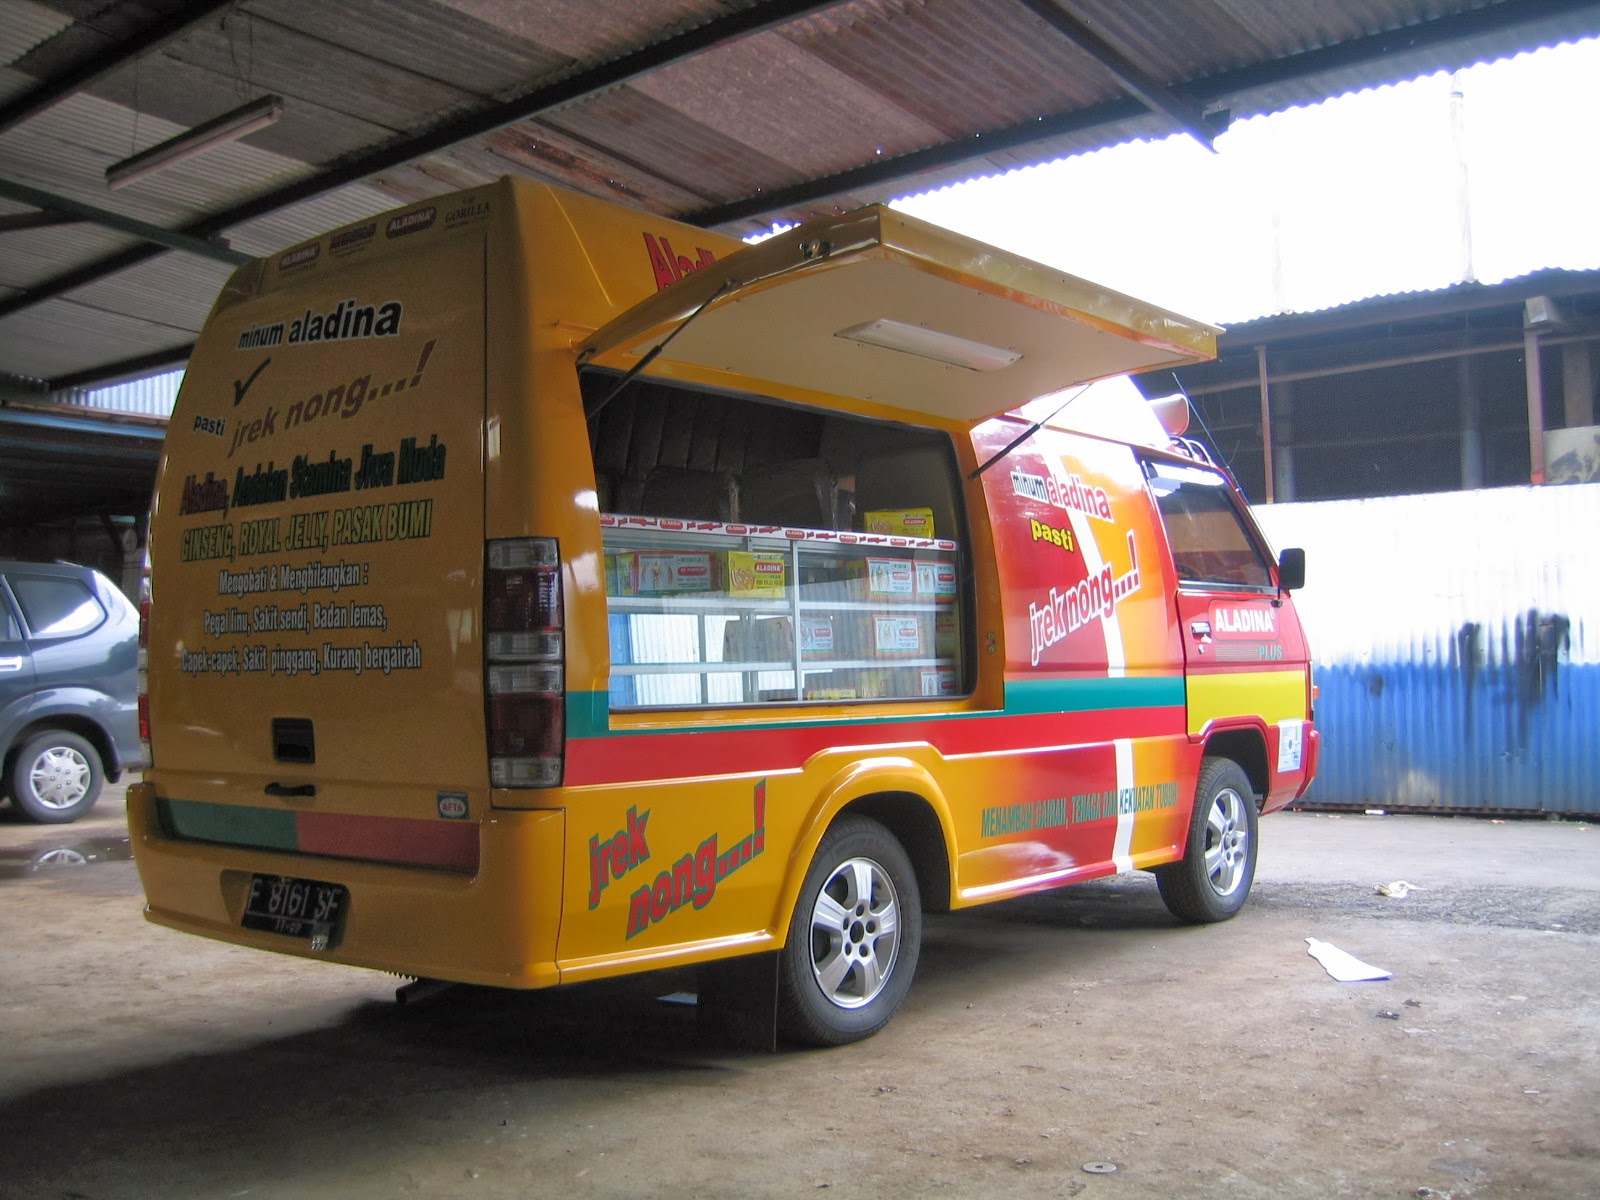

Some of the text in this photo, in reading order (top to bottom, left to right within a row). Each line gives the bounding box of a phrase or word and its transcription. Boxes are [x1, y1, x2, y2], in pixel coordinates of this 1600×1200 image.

[390, 209, 432, 231] ALADINA
[237, 300, 402, 349] minum aladina
[193, 414, 226, 437] pasti
[228, 406, 280, 458] jrek
[1011, 466, 1115, 523] minum aladina
[181, 499, 433, 563] GINSENG, ROYAL JELLY, PASAK BUMI
[1030, 518, 1074, 552] pasti
[218, 565, 268, 598] Mengobati
[270, 566, 278, 590] &
[280, 560, 360, 597] Menghilangkan
[204, 602, 387, 638] Pegal linu, Sakit sendi, Badan lemas,
[1215, 608, 1274, 632] ALADINA
[181, 640, 421, 676] Capek-capek, Sakit pinggang, Kurang bergairah
[1258, 645, 1282, 660] PLUS
[981, 802, 1034, 838] MENAMBAH
[1072, 793, 1101, 823] TENAGA
[1119, 785, 1155, 815] KEKUATAN
[588, 804, 650, 910] jrek
[248, 878, 341, 920] F 8161 SF
